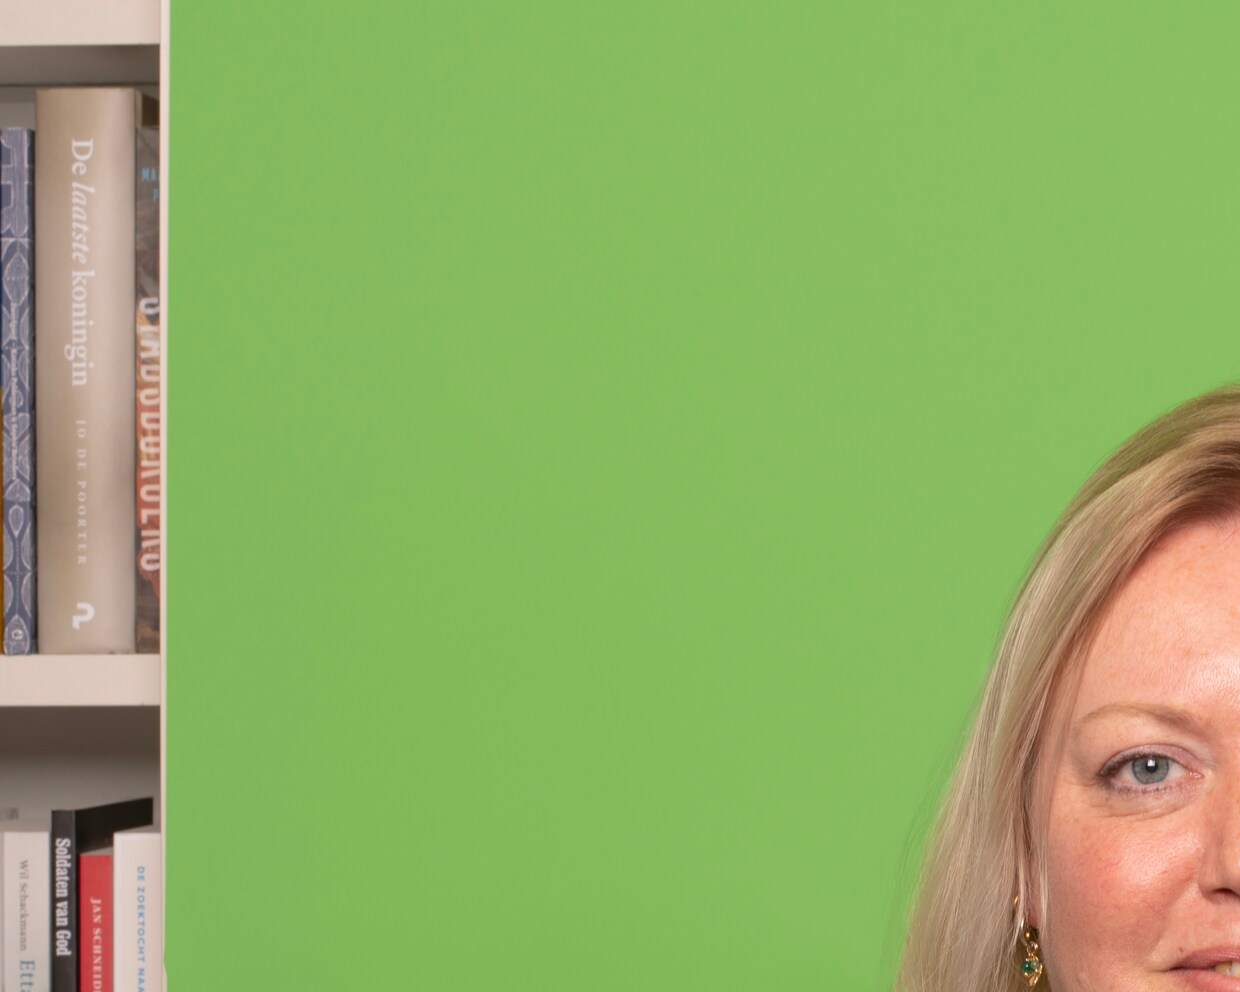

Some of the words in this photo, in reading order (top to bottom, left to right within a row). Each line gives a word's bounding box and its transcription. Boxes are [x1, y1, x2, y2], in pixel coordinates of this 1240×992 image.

[72, 139, 94, 175] De
[71, 183, 95, 263] laatste
[65, 270, 95, 386] koningin
[19, 860, 28, 879] Wil
[55, 839, 71, 898] Soldaten
[137, 867, 145, 882] DE
[56, 901, 68, 926] van
[89, 898, 102, 923] JAN
[136, 886, 146, 962] ZOEKTOCHT
[55, 930, 71, 956] God
